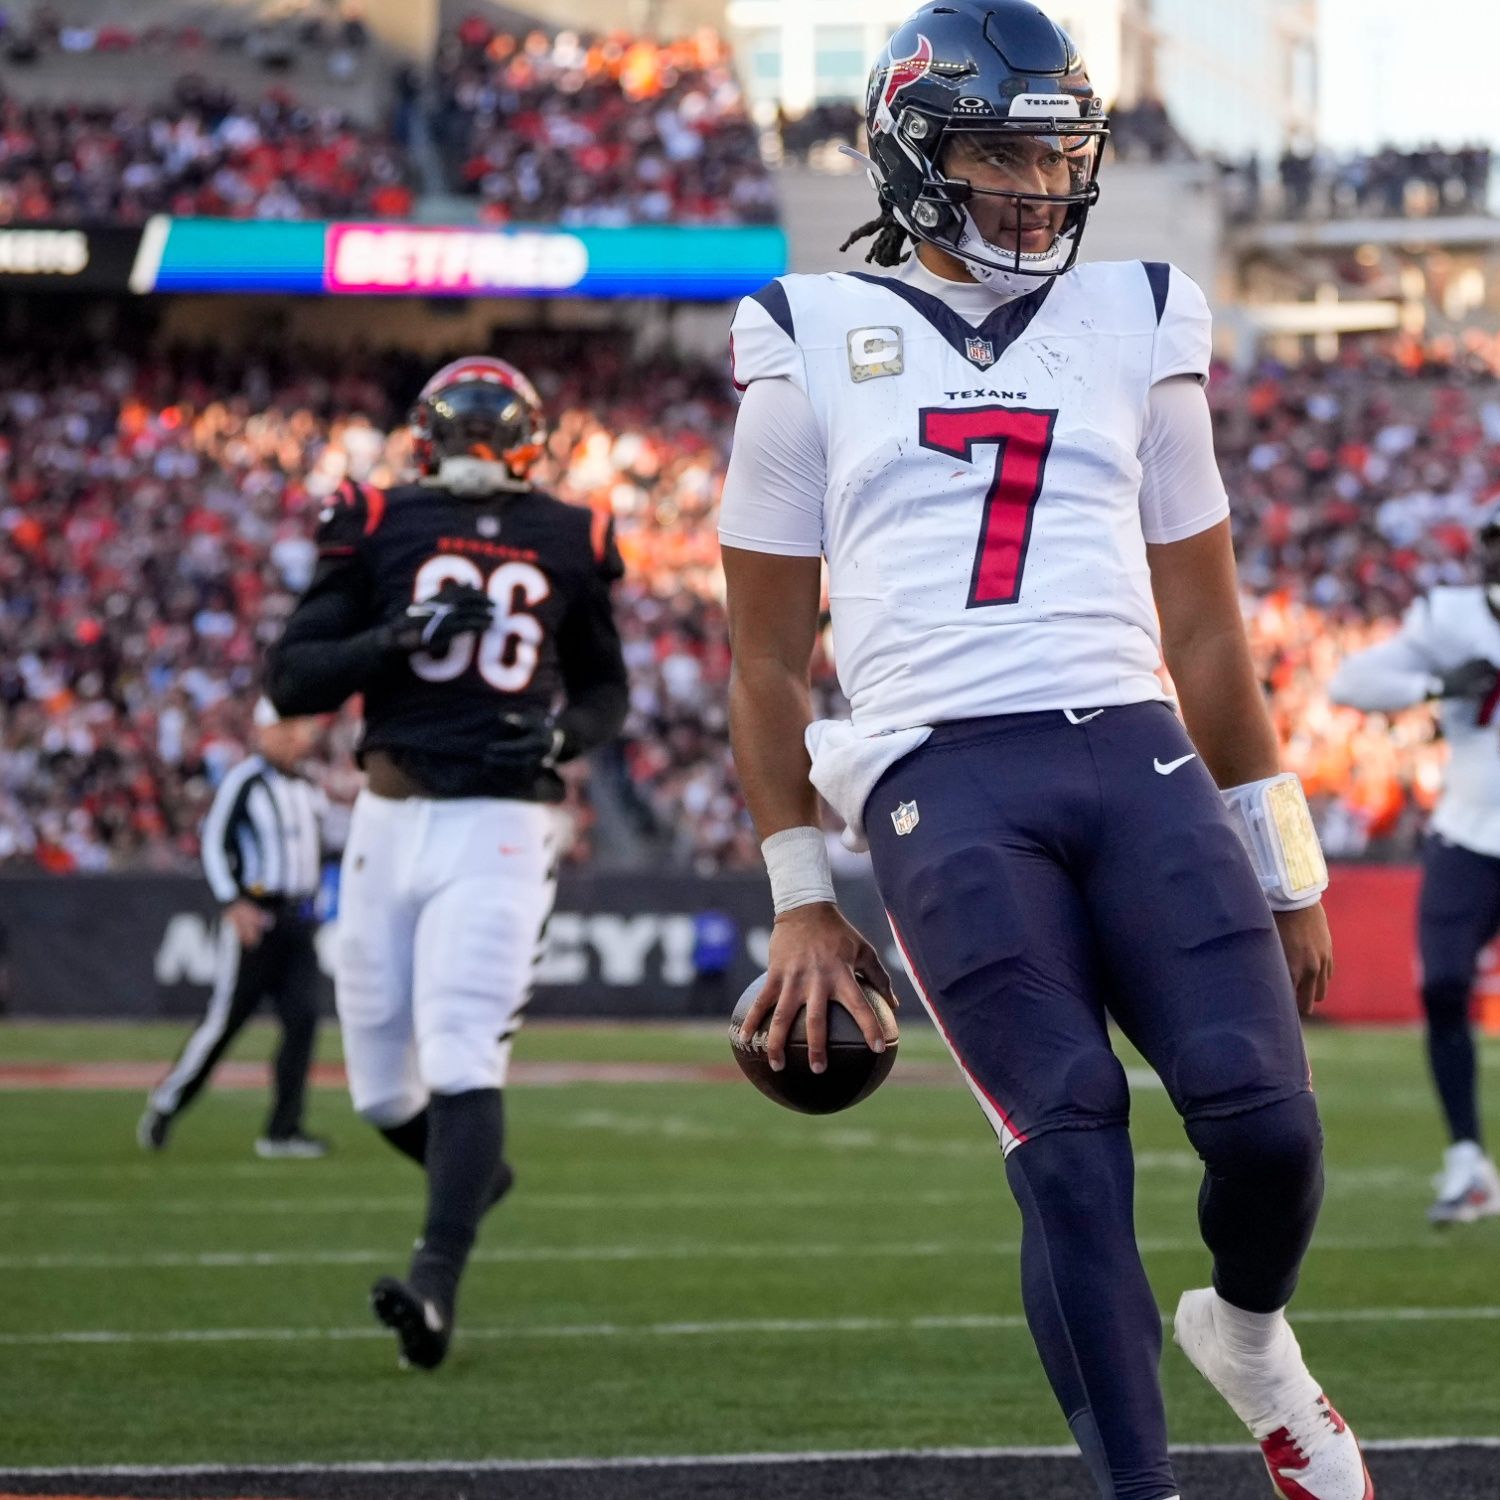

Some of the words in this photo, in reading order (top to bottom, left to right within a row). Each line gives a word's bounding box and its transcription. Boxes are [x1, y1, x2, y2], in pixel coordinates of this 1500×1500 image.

[337, 230, 588, 289] BETFRED
[851, 328, 900, 364] C
[944, 389, 1027, 401] TEXANS
[919, 404, 1059, 609] 7
